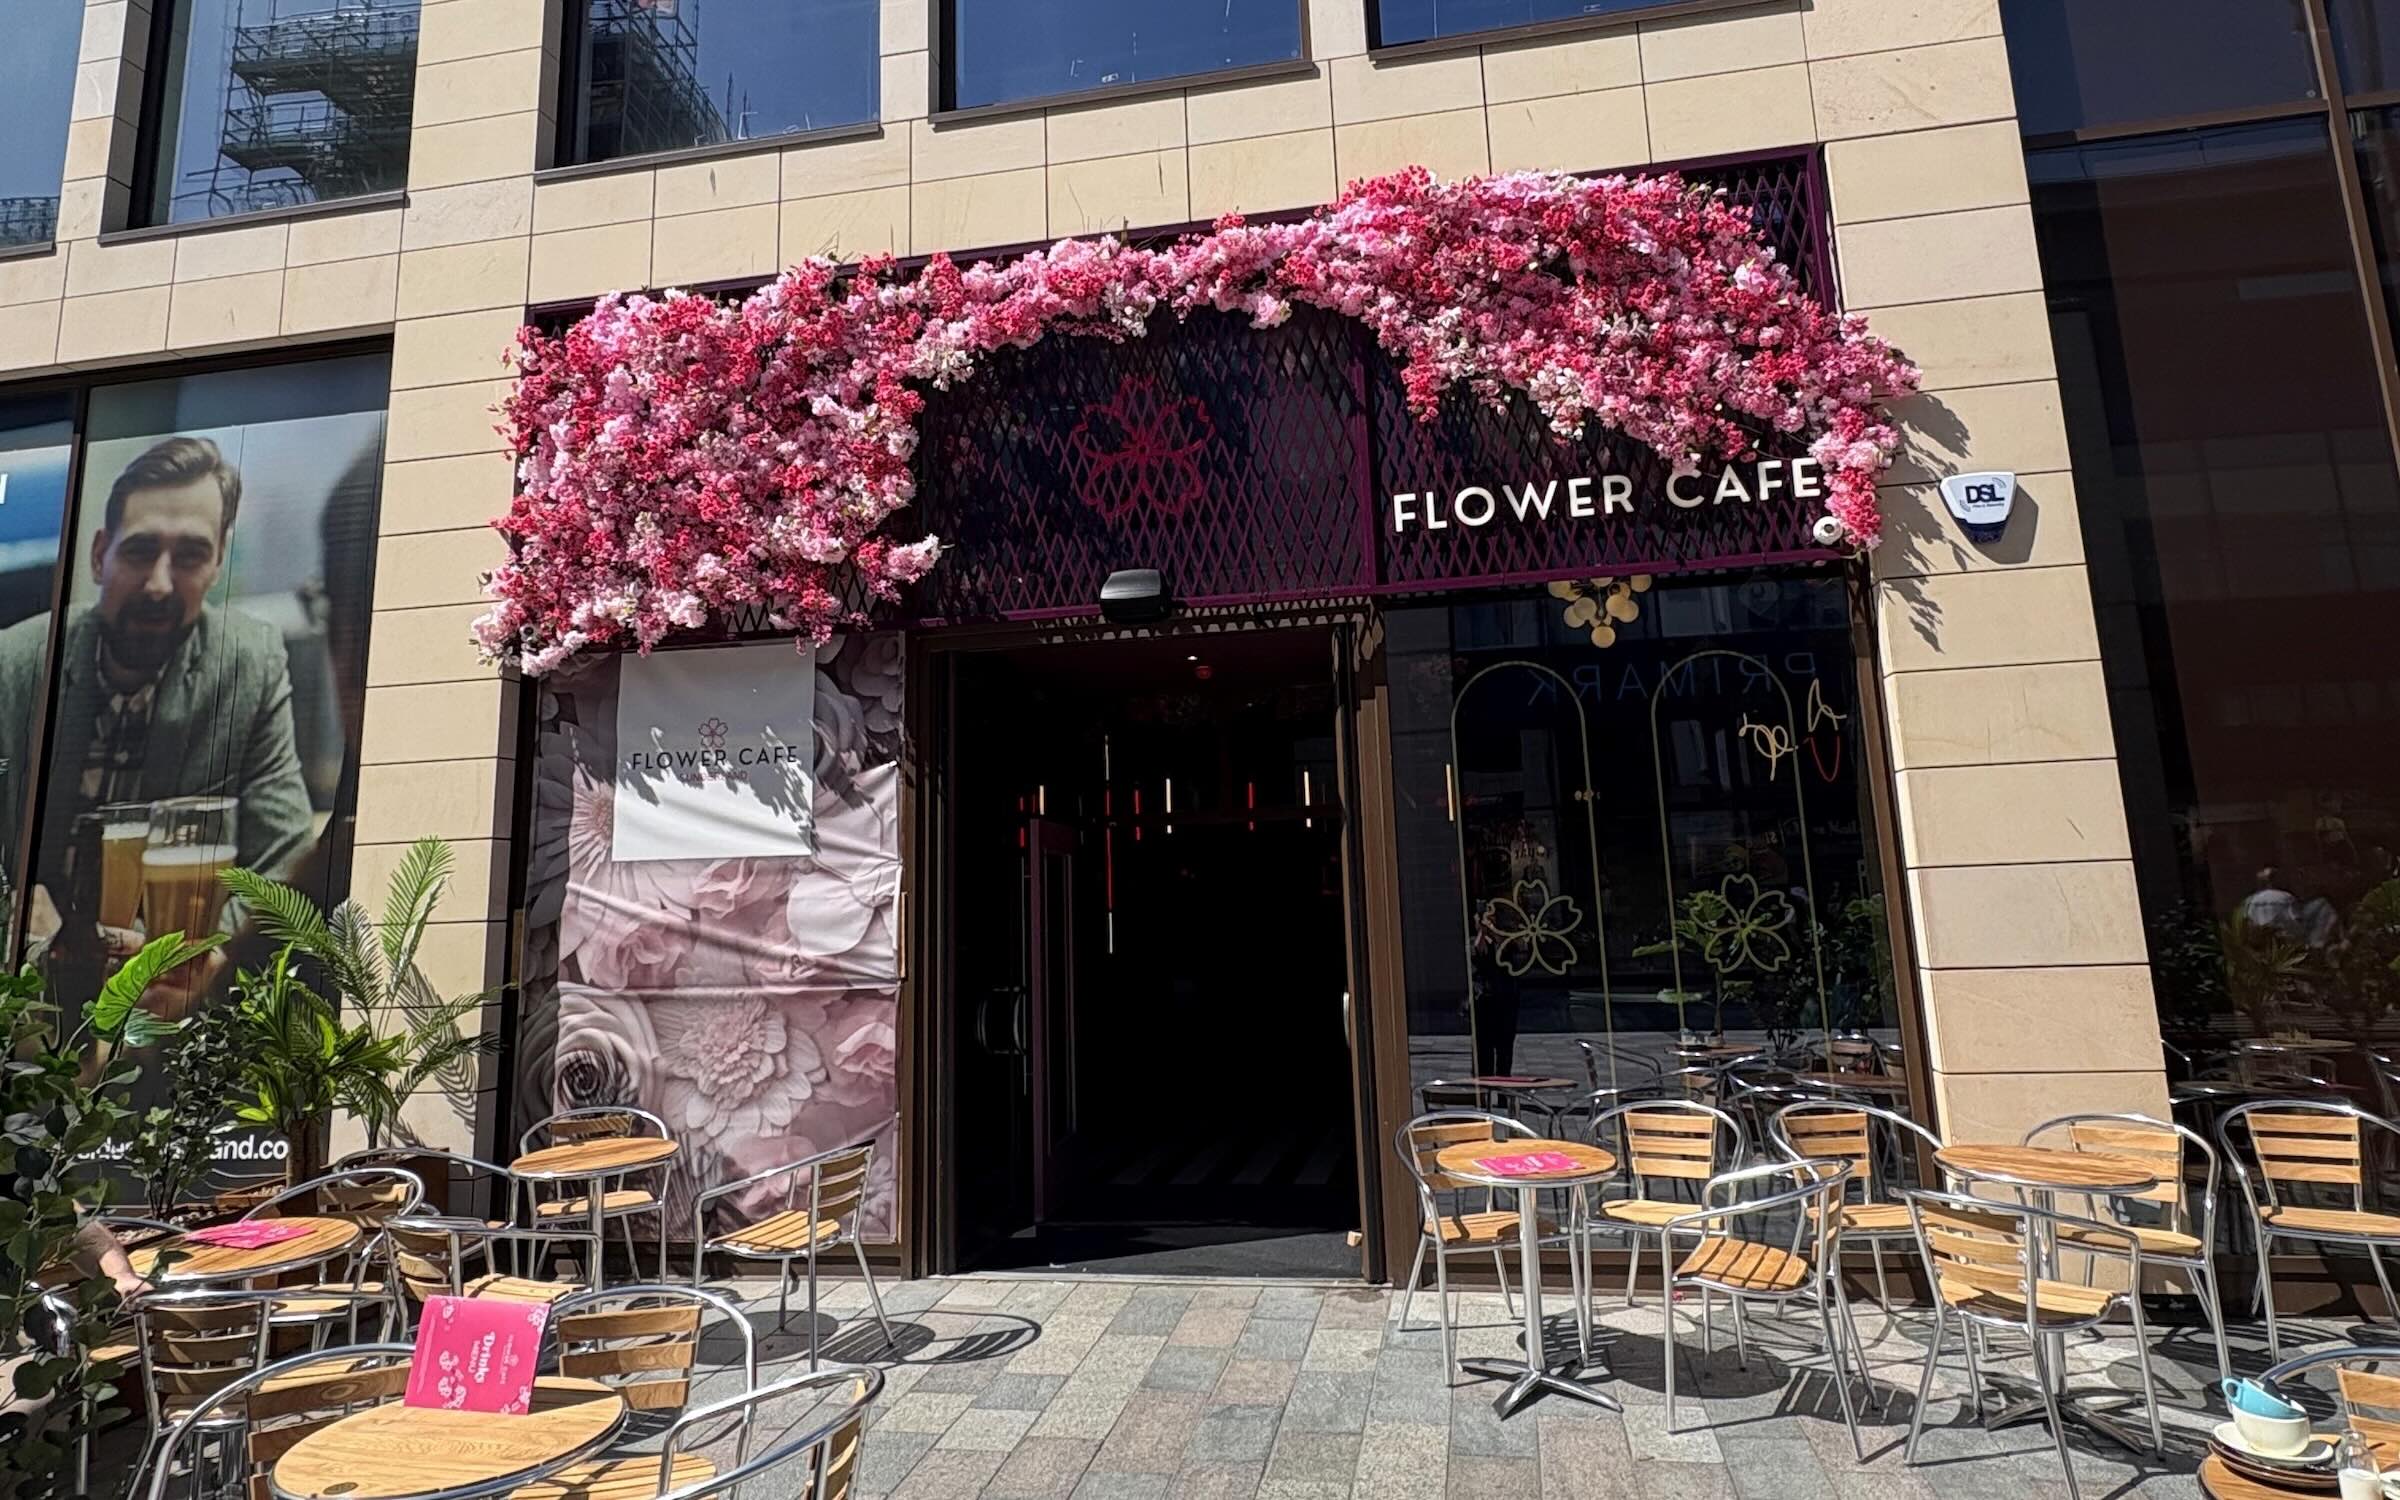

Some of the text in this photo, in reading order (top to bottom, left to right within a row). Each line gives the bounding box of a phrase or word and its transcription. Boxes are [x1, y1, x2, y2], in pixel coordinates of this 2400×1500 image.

[1393, 457, 1821, 532] FLOWER CAFE
[1965, 484, 2005, 504] DSL
[632, 745, 798, 770] FLOWER CAFE
[474, 1331, 496, 1383] Drinks
